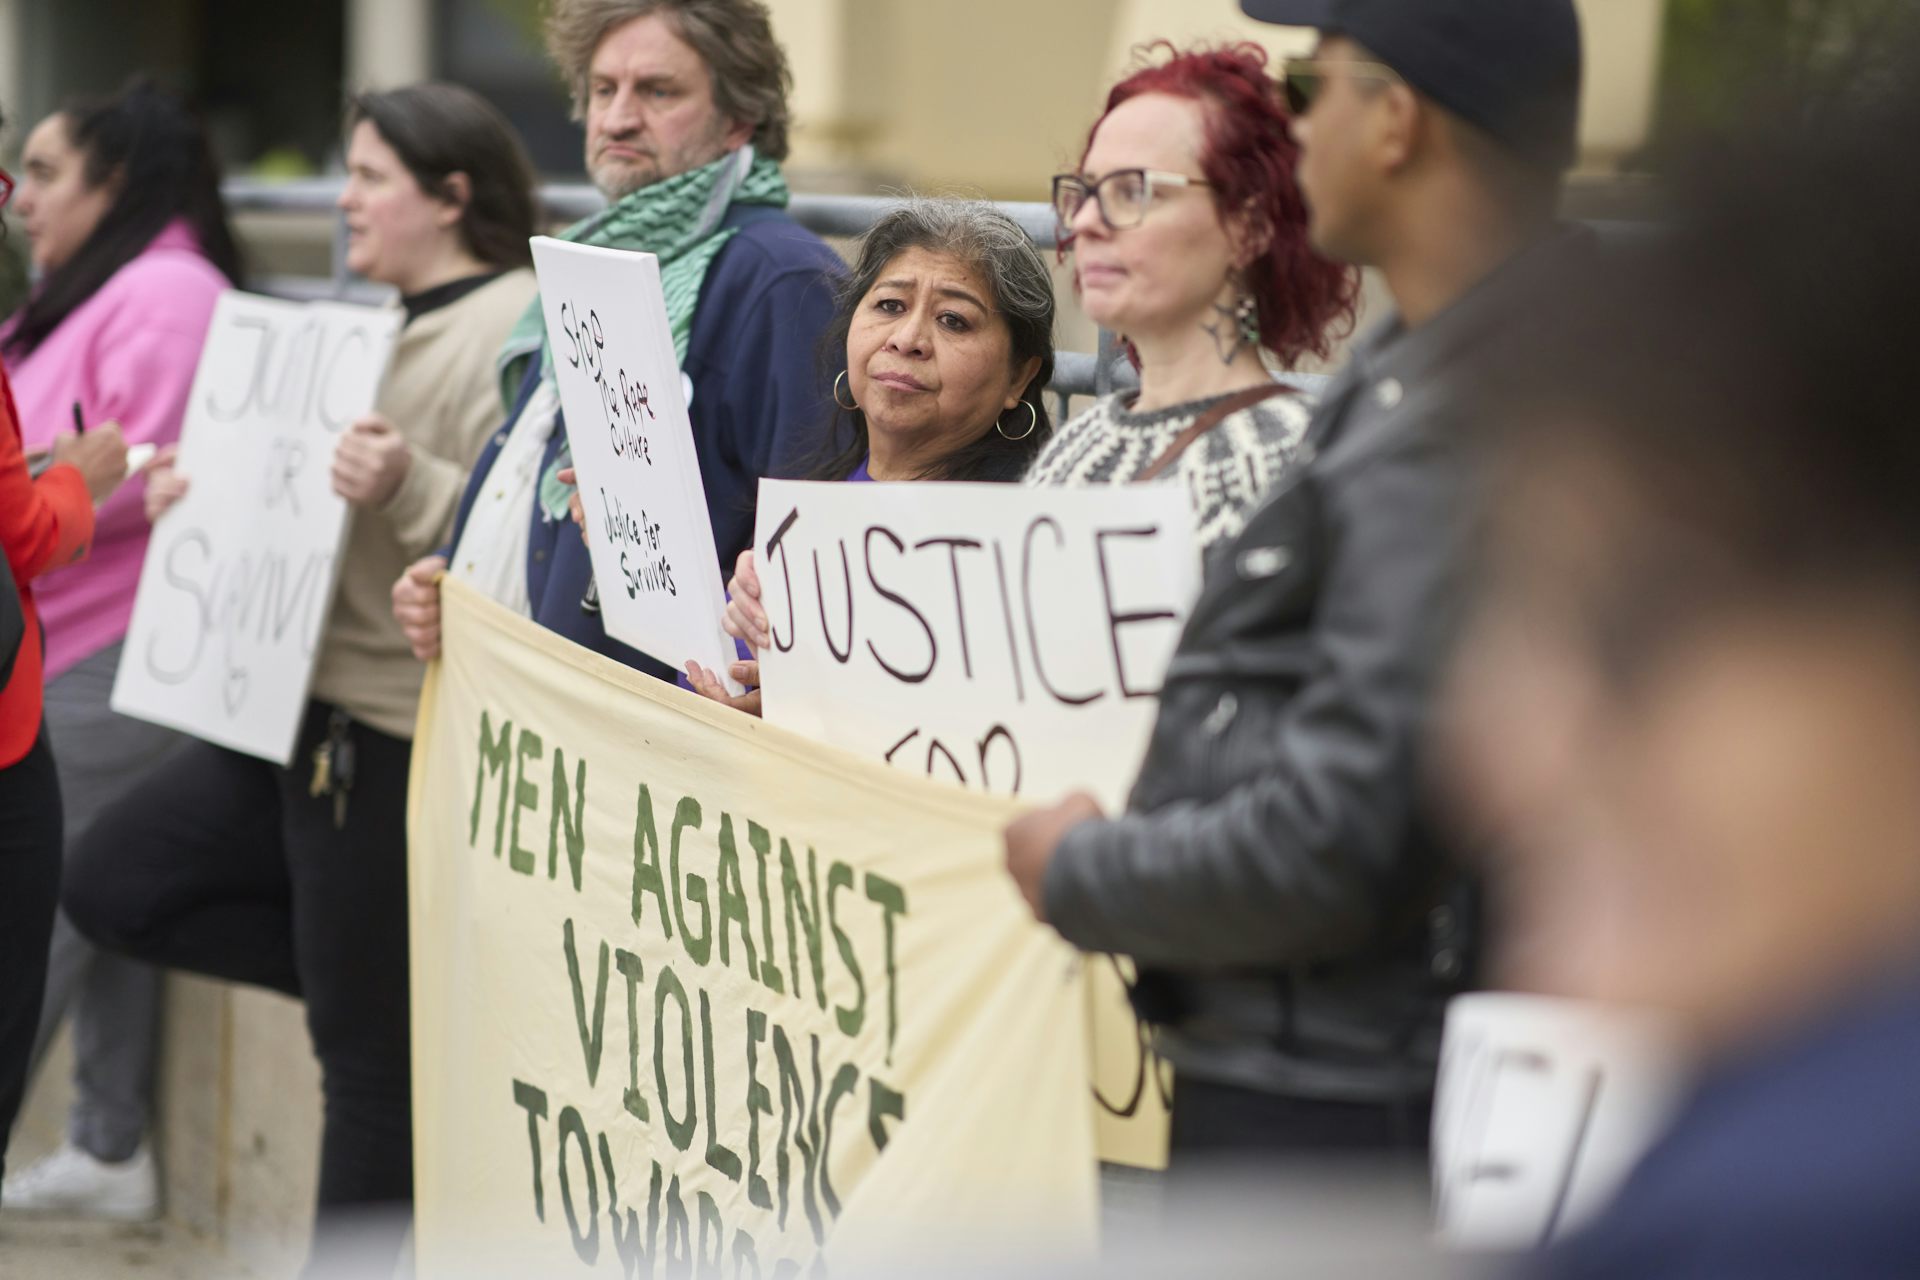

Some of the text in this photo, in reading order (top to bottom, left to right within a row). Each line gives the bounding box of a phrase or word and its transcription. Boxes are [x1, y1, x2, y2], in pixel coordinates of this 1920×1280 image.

[561, 298, 604, 376] Stop
[619, 368, 656, 432] Rape
[610, 422, 652, 467] Culture
[600, 487, 661, 551] Justice for
[766, 506, 1176, 706] JUSTICE
[469, 709, 587, 893] MEN
[631, 782, 908, 1068] AGAINST
